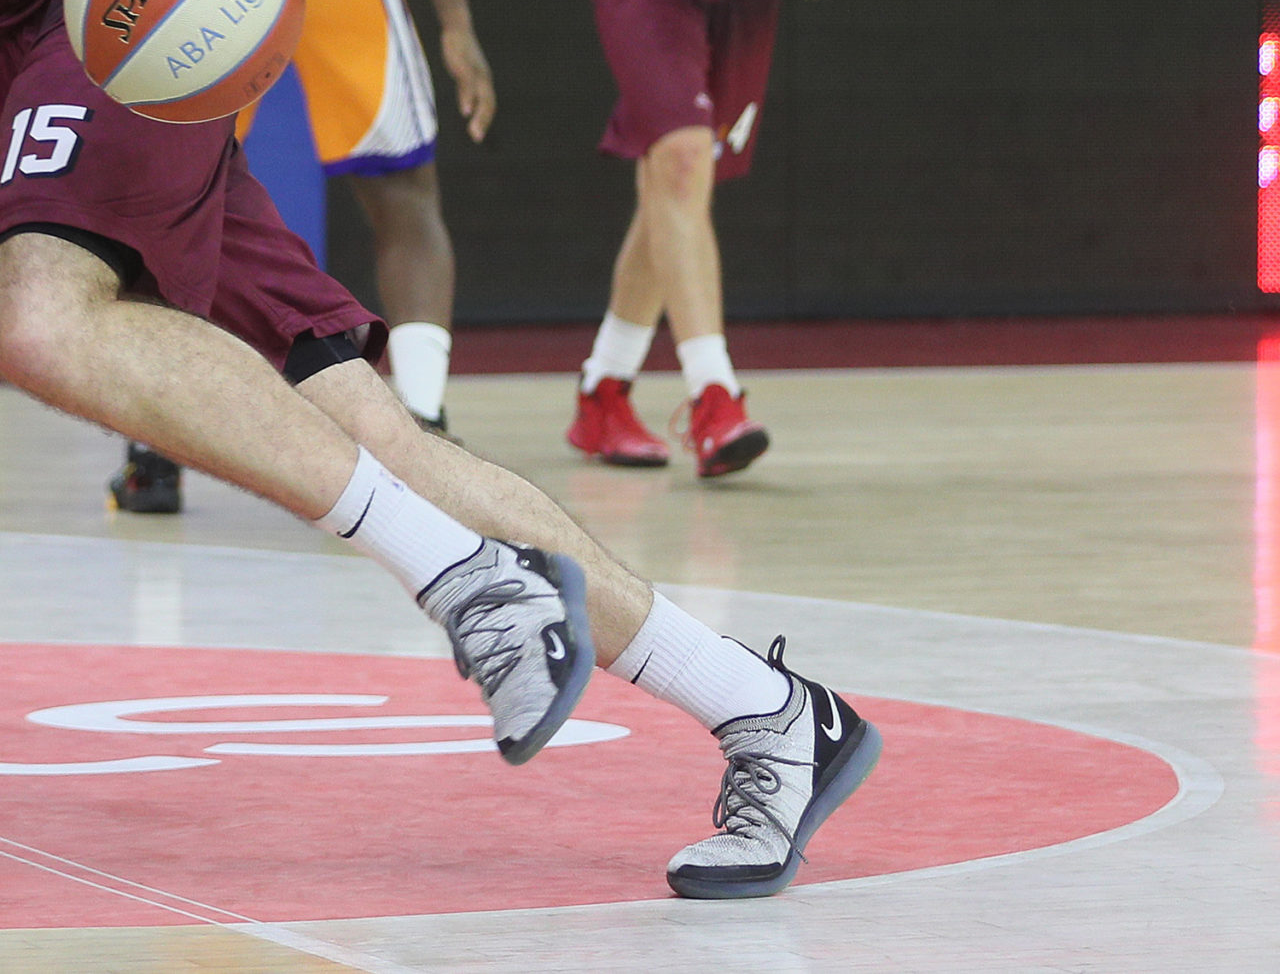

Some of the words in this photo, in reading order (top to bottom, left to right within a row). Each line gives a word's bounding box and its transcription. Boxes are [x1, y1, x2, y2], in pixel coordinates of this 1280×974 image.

[164, 26, 226, 79] ABA
[0, 103, 89, 185] 15
[726, 100, 758, 154] 4
